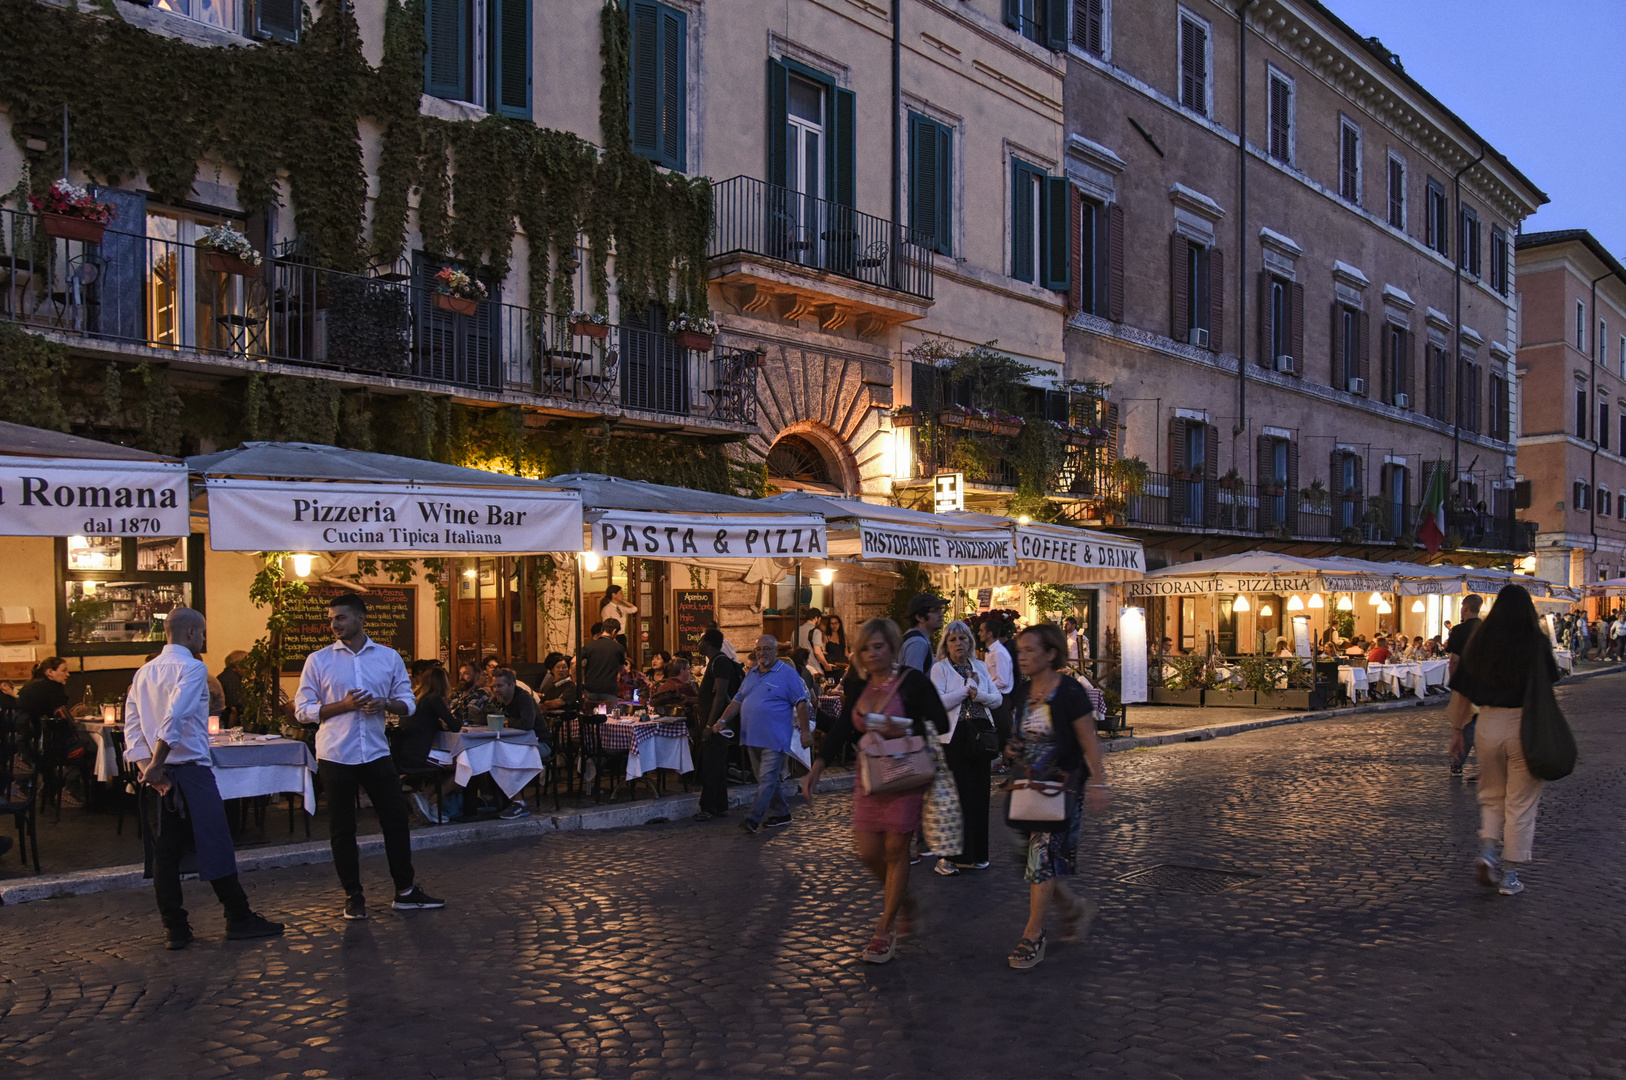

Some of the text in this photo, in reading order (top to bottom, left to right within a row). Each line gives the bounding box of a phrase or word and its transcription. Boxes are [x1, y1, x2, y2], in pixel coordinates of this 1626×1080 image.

[18, 476, 178, 508] Romana
[83, 518, 161, 533] dal 1870
[292, 499, 527, 526] Pizzeria Wine Bar
[322, 527, 502, 546] Cucina Tipica Italiana
[602, 523, 821, 554] PASTA & PIZZA
[864, 530, 1009, 559] RISTORANTE PANZIRONE
[1021, 536, 1138, 568] COFFEE & DRINK
[1131, 579, 1224, 596] RISTORANTE
[1237, 578, 1311, 592] PIZZERIA
[1417, 582, 1444, 595] PIZZERIA
